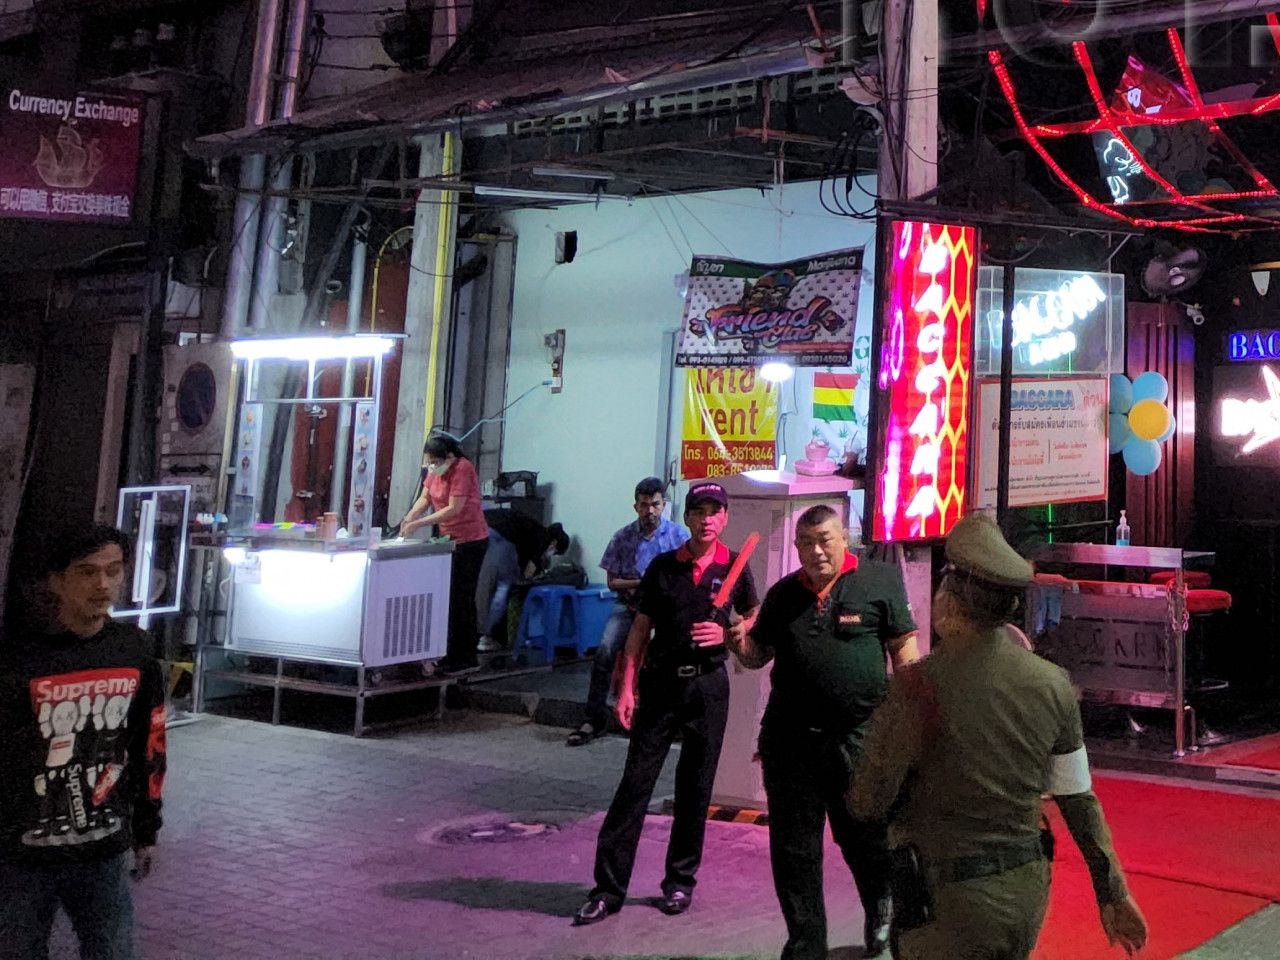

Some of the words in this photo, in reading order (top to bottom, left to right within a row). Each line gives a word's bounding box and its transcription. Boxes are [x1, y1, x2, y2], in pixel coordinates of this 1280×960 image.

[9, 89, 72, 121] Currency
[74, 96, 140, 128] Exchange
[700, 400, 760, 436] rent
[36, 675, 138, 703] Supreme
[66, 762, 87, 829] Supreme
